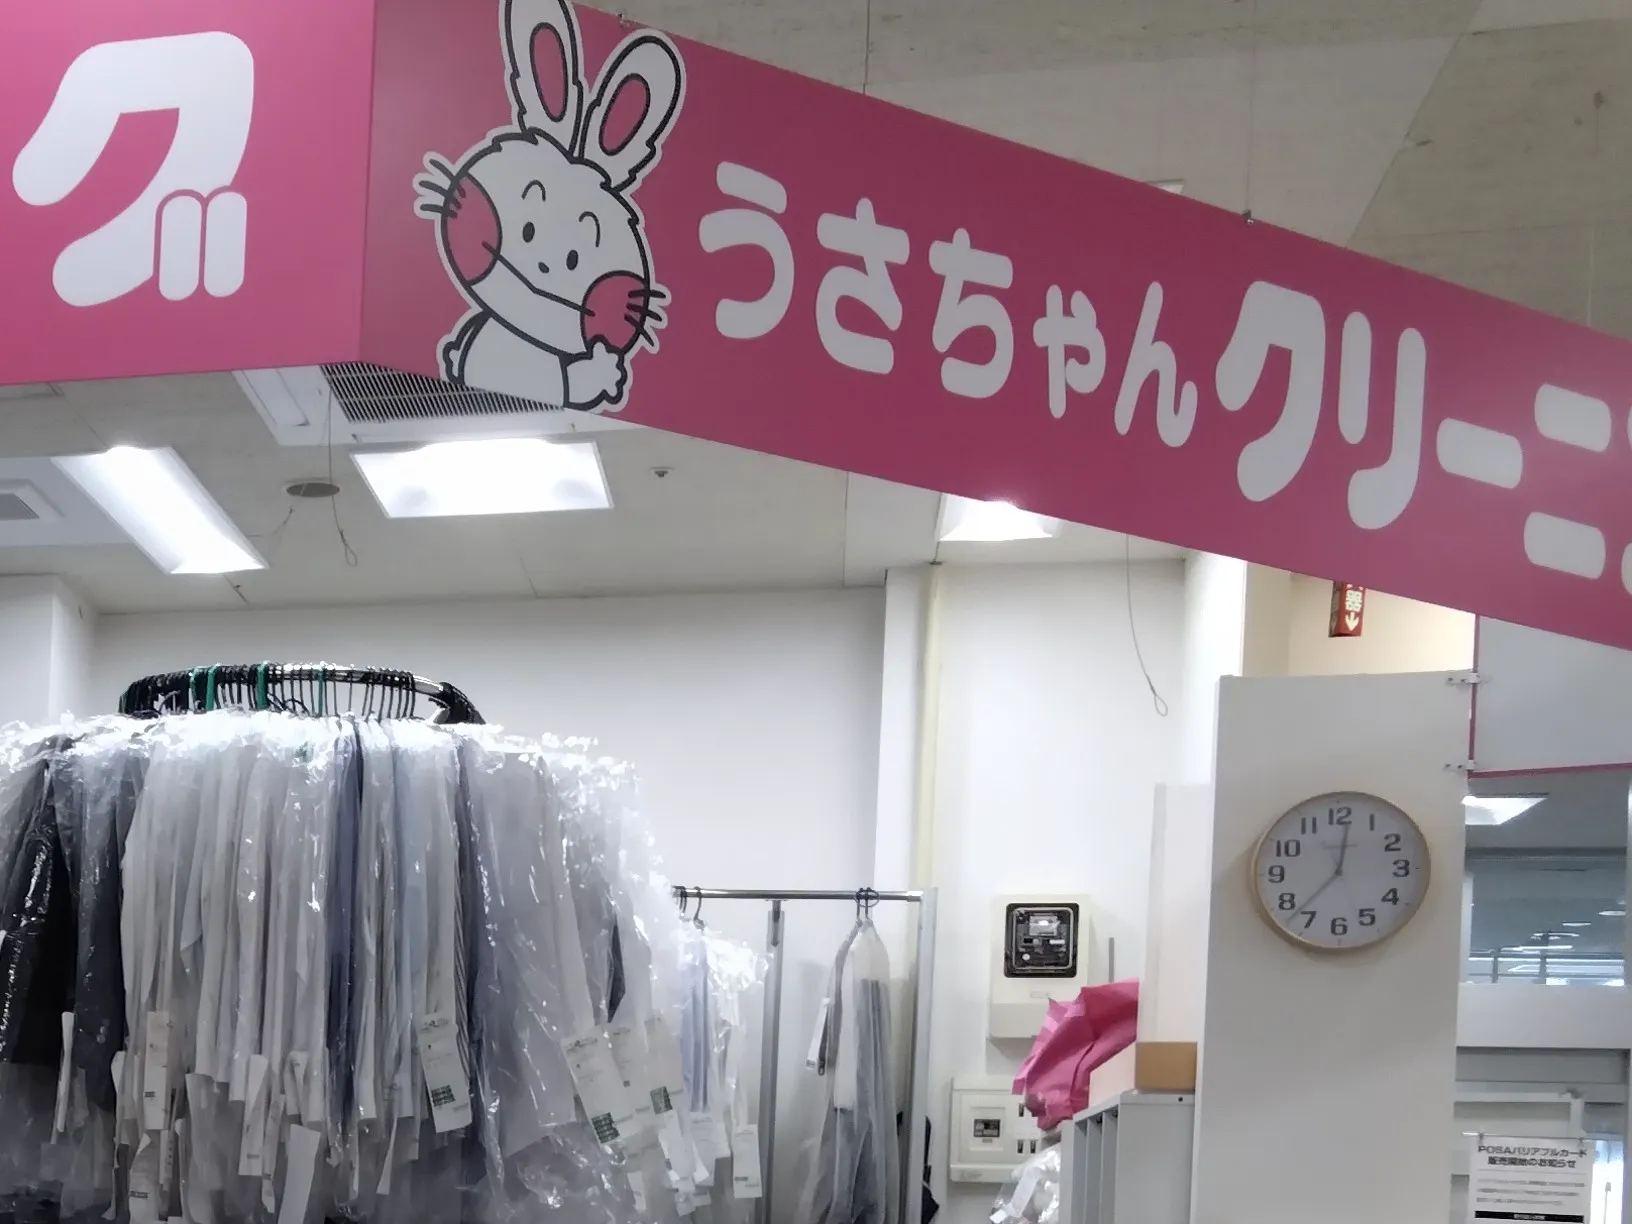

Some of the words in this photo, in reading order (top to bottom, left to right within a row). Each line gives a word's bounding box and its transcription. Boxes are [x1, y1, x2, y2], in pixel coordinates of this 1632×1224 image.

[699, 161, 1632, 594] うさちゃんクリーニ
[1328, 806, 1352, 826] 12
[1369, 813, 1375, 831] 1
[1300, 817, 1318, 835] 11
[1276, 839, 1301, 857] 10
[1384, 833, 1401, 852] 2
[1268, 864, 1285, 883] 9
[1392, 859, 1410, 877] 3
[1278, 892, 1296, 910] 8
[1381, 888, 1400, 905] 4
[1300, 910, 1317, 928] 7
[1358, 908, 1376, 926] 5
[1330, 917, 1348, 936] 6
